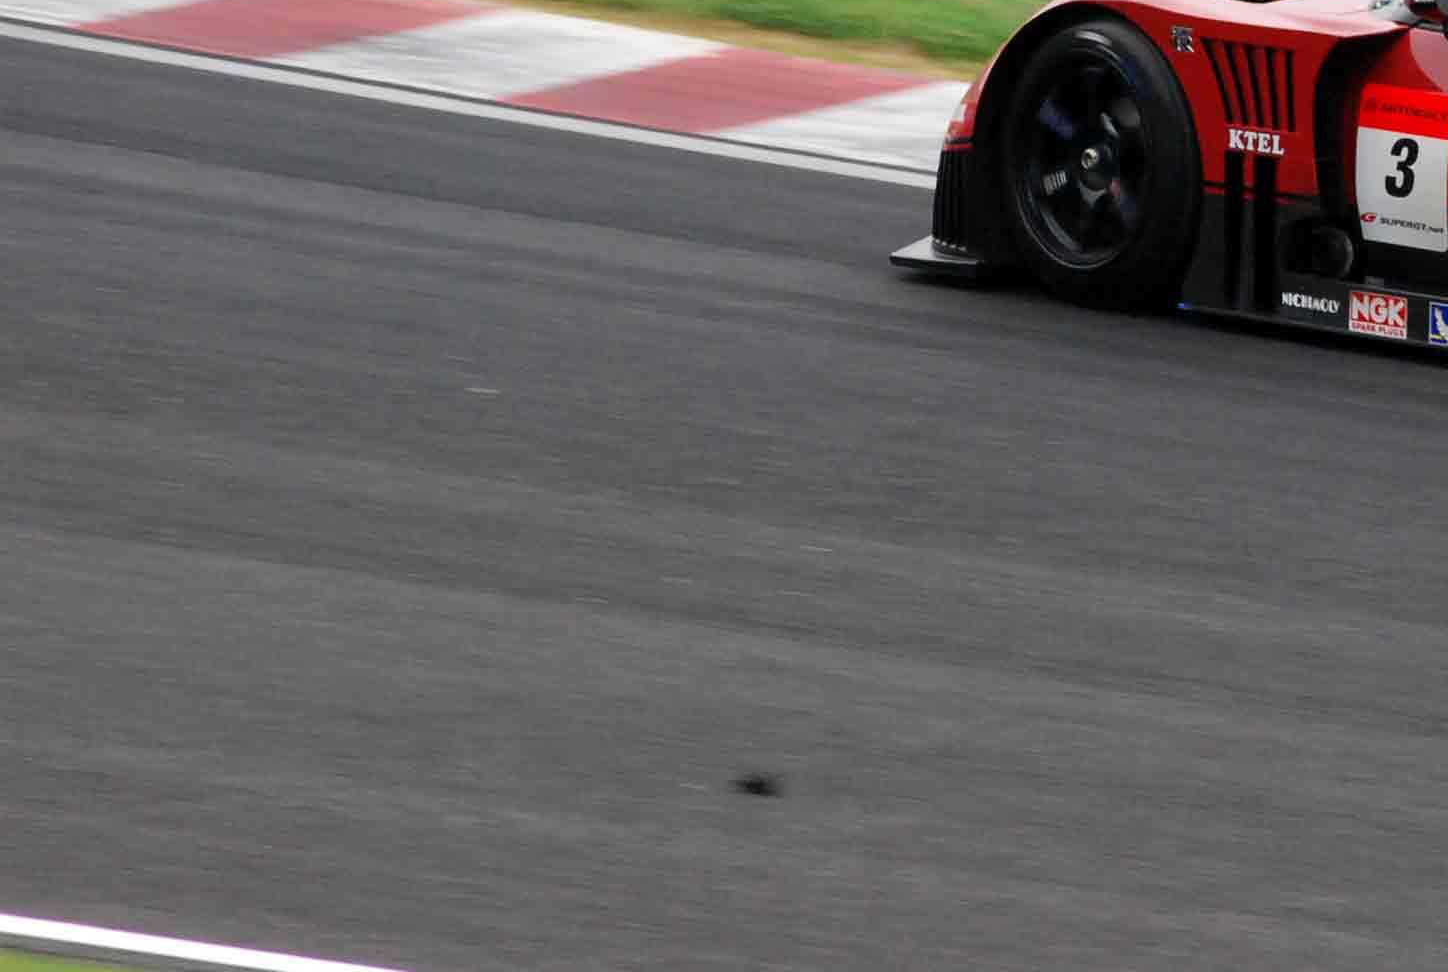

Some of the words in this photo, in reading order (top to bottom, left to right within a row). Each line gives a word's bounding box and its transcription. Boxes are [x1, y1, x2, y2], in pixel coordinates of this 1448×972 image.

[1228, 128, 1285, 156] KTEL
[1384, 138, 1419, 198] 3
[1350, 294, 1405, 326] NGK
